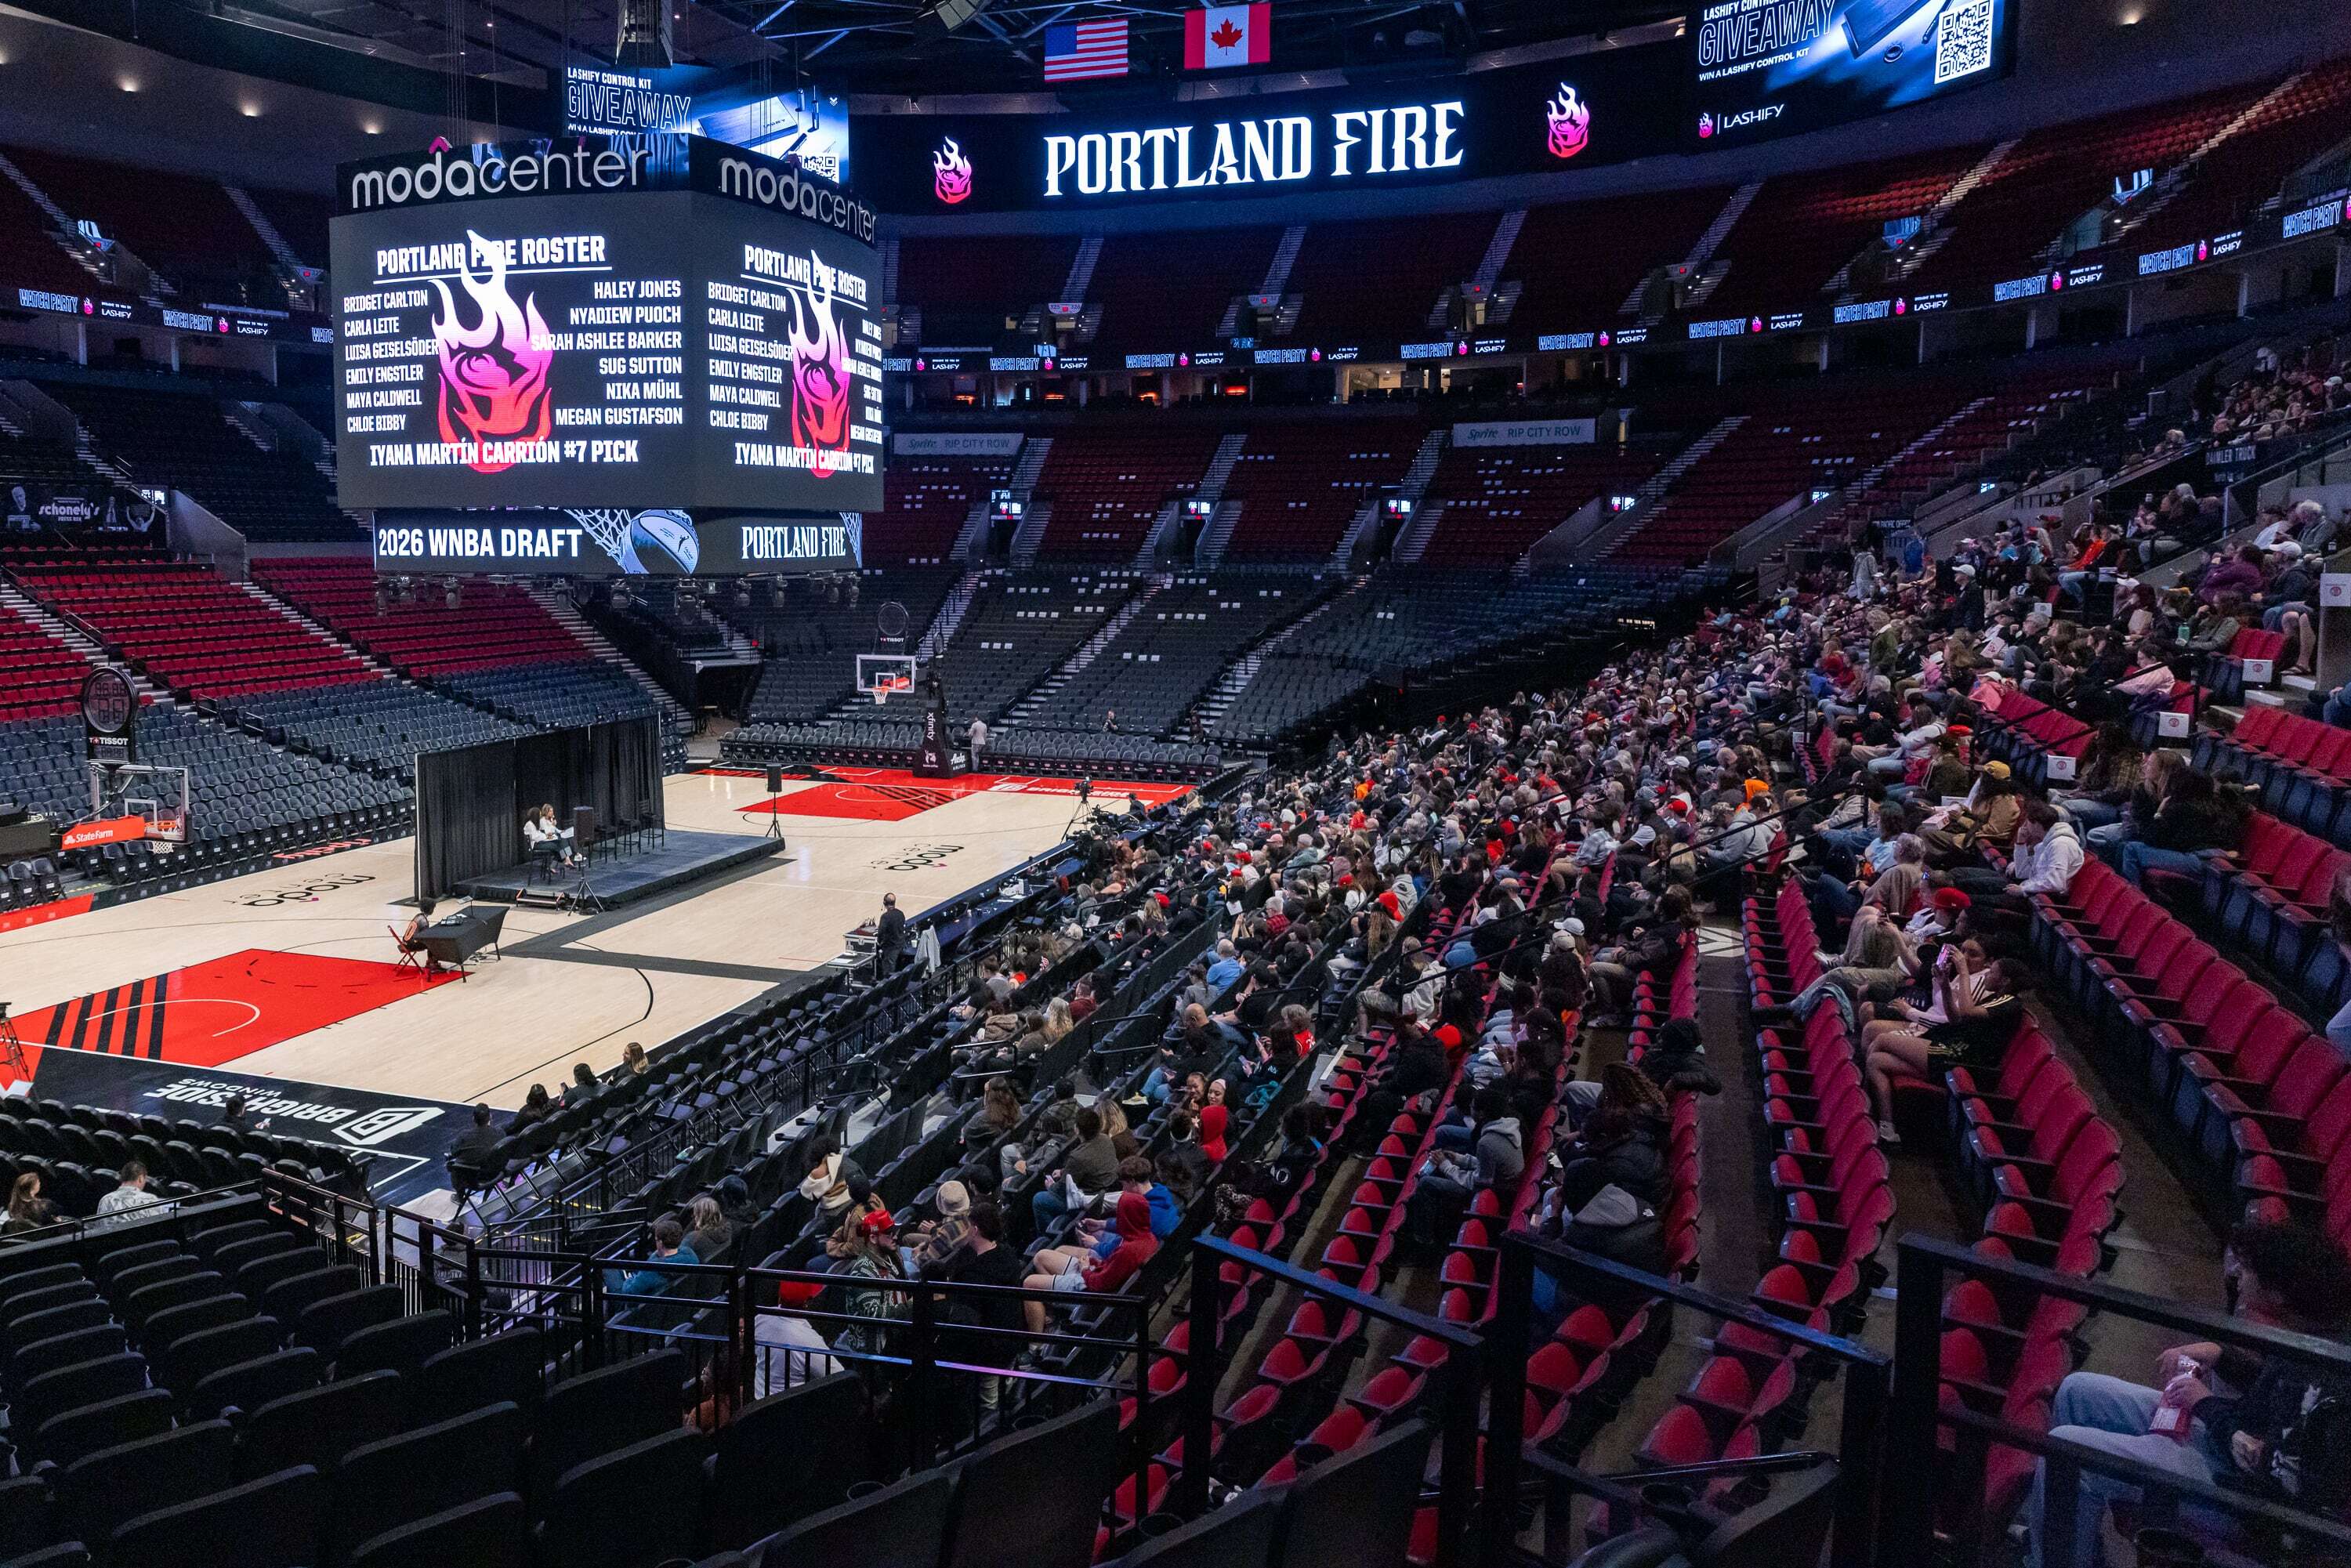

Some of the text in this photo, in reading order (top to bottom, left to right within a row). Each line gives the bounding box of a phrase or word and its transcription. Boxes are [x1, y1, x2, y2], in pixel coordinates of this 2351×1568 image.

[1704, 2, 1739, 21] LASHIFY
[1699, 0, 1835, 66] GIVEAWAY
[1699, 71, 1715, 81] WIN
[1722, 62, 1755, 76] LASHIFY
[1756, 52, 1795, 67] CONTROL
[1796, 48, 1809, 58] KIT
[568, 67, 651, 89] LASHIFY CONTROL KIT
[568, 81, 691, 130] GIVEAWAY
[1724, 104, 1784, 129] LASHIFY
[1044, 101, 1465, 196] PORTLAND FIRE
[2283, 201, 2342, 238] WATCH PARTY
[377, 242, 465, 276] PORTLAND
[522, 235, 606, 265] ROSTER
[2213, 240, 2241, 255] LASHIFY
[744, 244, 810, 284] PORTLAND
[838, 270, 867, 302] ROSTER
[2139, 250, 2171, 275] WATCH
[594, 280, 681, 299] HALEY JONES
[1994, 274, 2047, 302] WATCH PARTY
[2070, 273, 2102, 286] LASHIFY
[19, 288, 50, 309] WATCH
[50, 293, 78, 313] PARTY
[344, 289, 428, 313] BRIDGET CARLTON
[708, 281, 786, 313] BRIDGET CARLTON
[1914, 300, 1948, 311] LASHIFY
[101, 308, 131, 319] LASHIFY
[163, 310, 213, 331] WATCH PARTY
[570, 305, 681, 324] NYADIEW PUOCH
[708, 307, 764, 332] CARLA LEITE
[1835, 300, 1891, 324] WATCH PARTY
[237, 326, 268, 335] LASHIFY
[312, 327, 333, 343] WATC
[344, 317, 400, 337] CARLA LEITE
[1689, 318, 1747, 339] WATCH PARTY
[1770, 320, 1802, 330] LASHIFY
[345, 336, 439, 360] LUISA GEISELSÖDER
[531, 331, 682, 352] SARAH ASHLEE BARKER
[708, 333, 793, 361] LUISA GEISELSÖDER
[1401, 342, 1454, 358] WATCH PARTY
[1475, 345, 1505, 353] LASHIFY
[1538, 332, 1594, 351] WATCH PARTY
[1617, 335, 1646, 345] LASHIFY
[599, 357, 682, 375] SUG SUTTON
[888, 358, 911, 371] PARTY
[990, 357, 1039, 371] WATCH PARTY
[1125, 354, 1175, 368] WATCH PARTY
[1255, 349, 1306, 364] WATCH PARTY
[346, 364, 423, 385] EMILY ENGSTLER
[709, 359, 782, 384] EMILY ENGSTLER
[346, 389, 422, 409] MAYA CALDWELL
[606, 378, 683, 400] NIKA MÜHL
[709, 385, 781, 407] MAYA CALDWELL
[347, 414, 406, 433] CHLOE BIBBY
[556, 407, 683, 425] MEGAN GUSTAFSON
[710, 410, 769, 431] CHLOE BIBBY
[1468, 425, 1581, 440] Sprite RIP CITY ROW
[370, 436, 639, 466] IYANA MARTÍN CARRIÓN #7 PICK
[945, 439, 959, 448] RIP
[962, 439, 984, 448] CITY
[987, 439, 1010, 448] ROW
[735, 442, 773, 465] IYANA
[776, 444, 817, 469] MARTÍN
[379, 528, 583, 558] 2026 WNBA DRAFT
[741, 526, 846, 559] PORTLAND FIRE
[927, 712, 936, 741] xfinity
[243, 875, 376, 907] moda
[178, 1078, 282, 1098] WINDOWS
[143, 1084, 357, 1123] BRIGHSIDE
